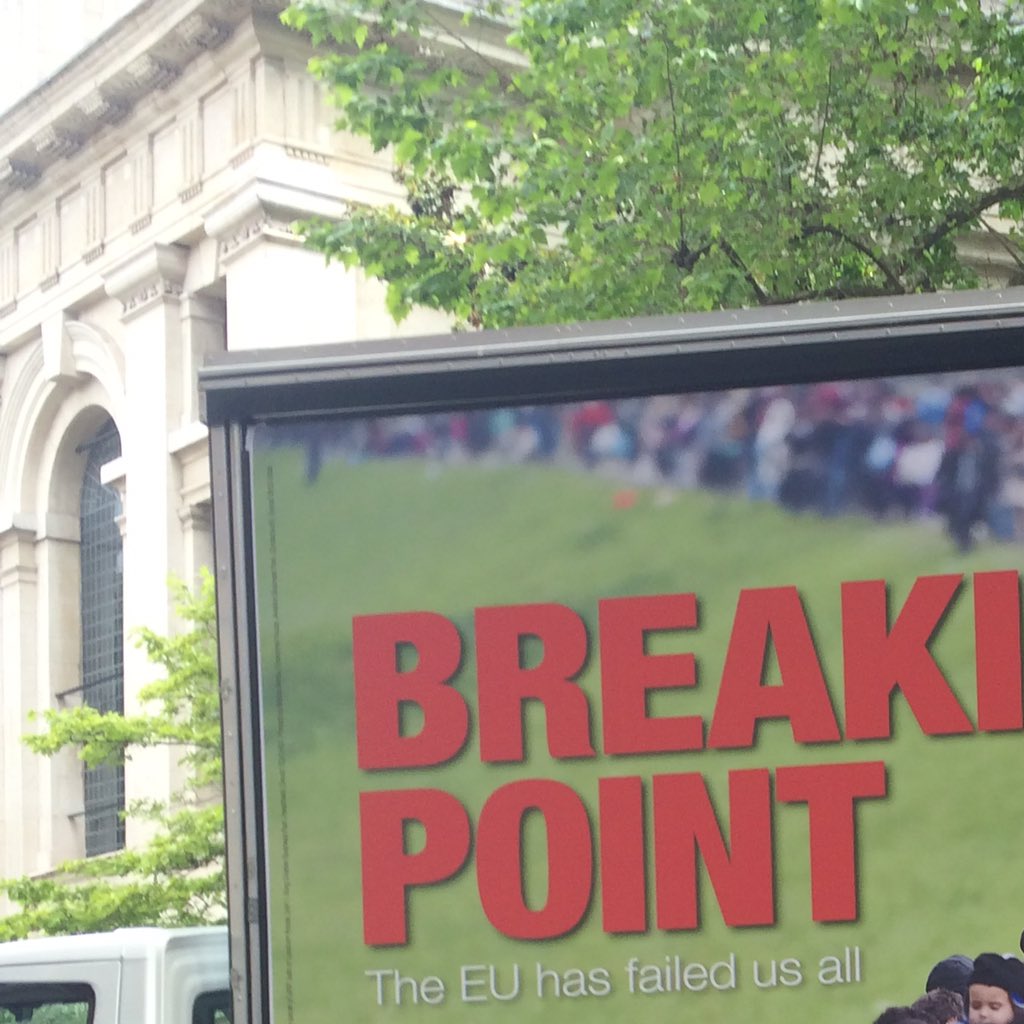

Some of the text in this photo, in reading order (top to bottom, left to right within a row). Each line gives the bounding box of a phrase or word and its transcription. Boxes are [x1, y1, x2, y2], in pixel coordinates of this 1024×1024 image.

[359, 761, 887, 947] POINT
[364, 946, 862, 1006] The EU has failed us all
